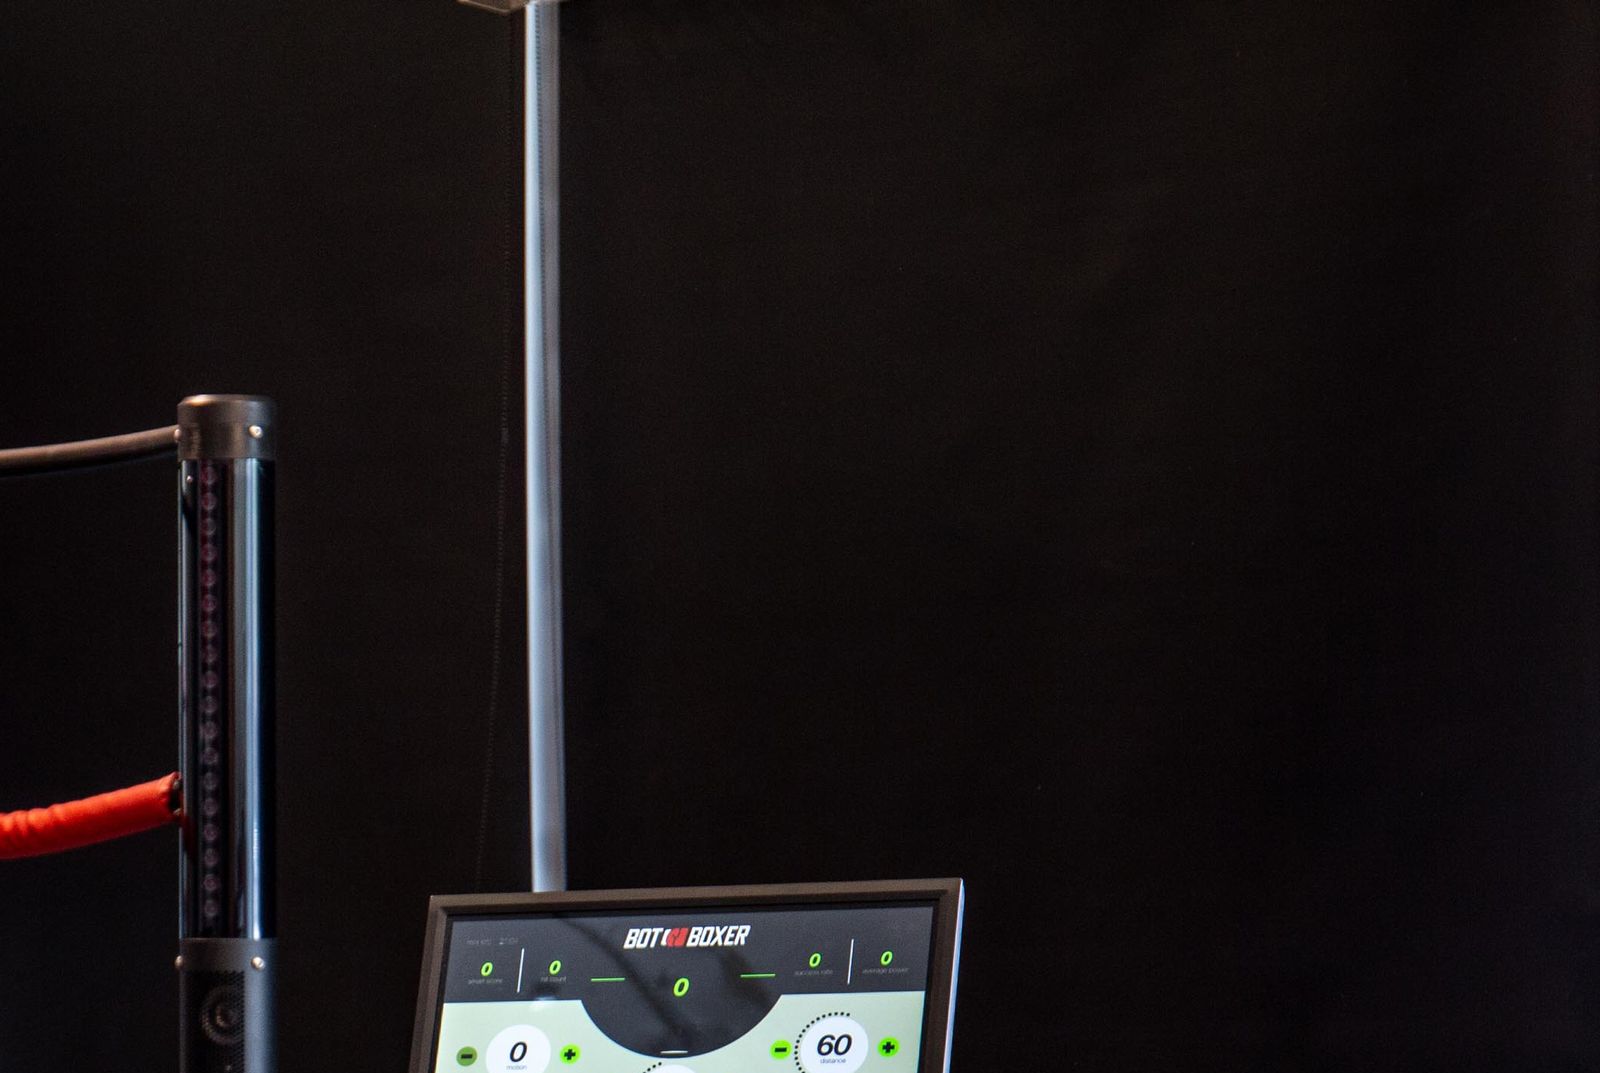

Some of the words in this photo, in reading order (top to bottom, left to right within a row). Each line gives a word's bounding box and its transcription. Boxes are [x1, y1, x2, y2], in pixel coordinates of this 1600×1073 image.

[623, 927, 664, 949] BOT
[686, 925, 751, 947] BOXER
[809, 953, 821, 968] 0
[880, 951, 893, 966] 0
[481, 961, 493, 976] 0
[549, 960, 561, 975] 0
[673, 977, 690, 997] 0
[509, 1041, 528, 1063] 0
[817, 1034, 853, 1056] 60
